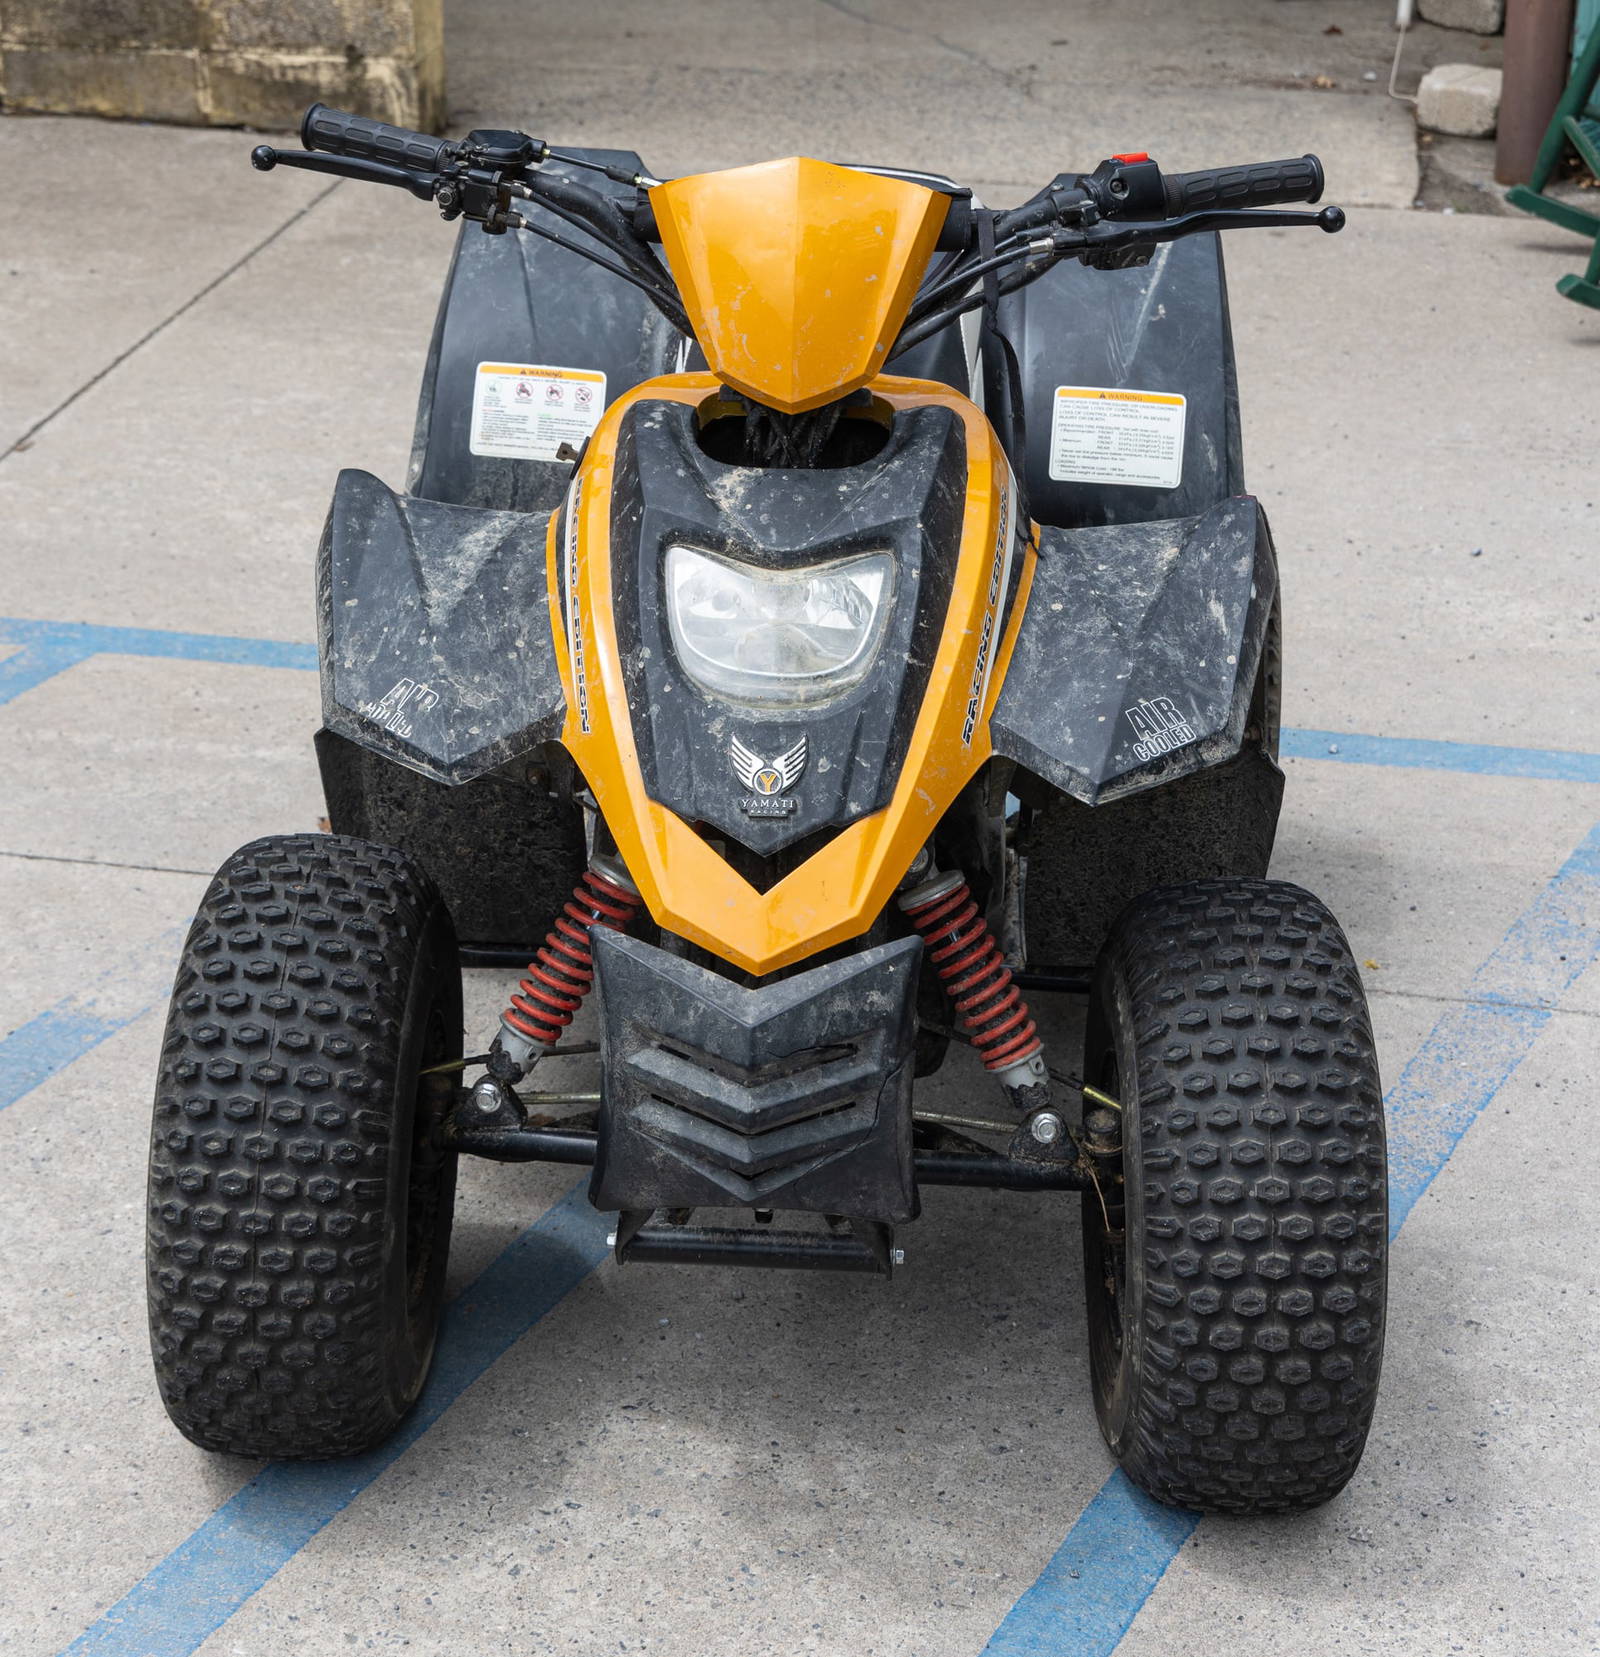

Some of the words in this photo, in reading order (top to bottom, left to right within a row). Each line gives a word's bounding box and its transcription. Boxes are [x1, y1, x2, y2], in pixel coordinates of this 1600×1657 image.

[1107, 392, 1143, 402] WARNING
[573, 594, 591, 734] EDITION
[961, 608, 992, 746] RACING
[1124, 696, 1187, 741] AIR
[1132, 723, 1197, 761] COOLED
[758, 773, 777, 793] Y
[741, 799, 794, 809] YAMATI
